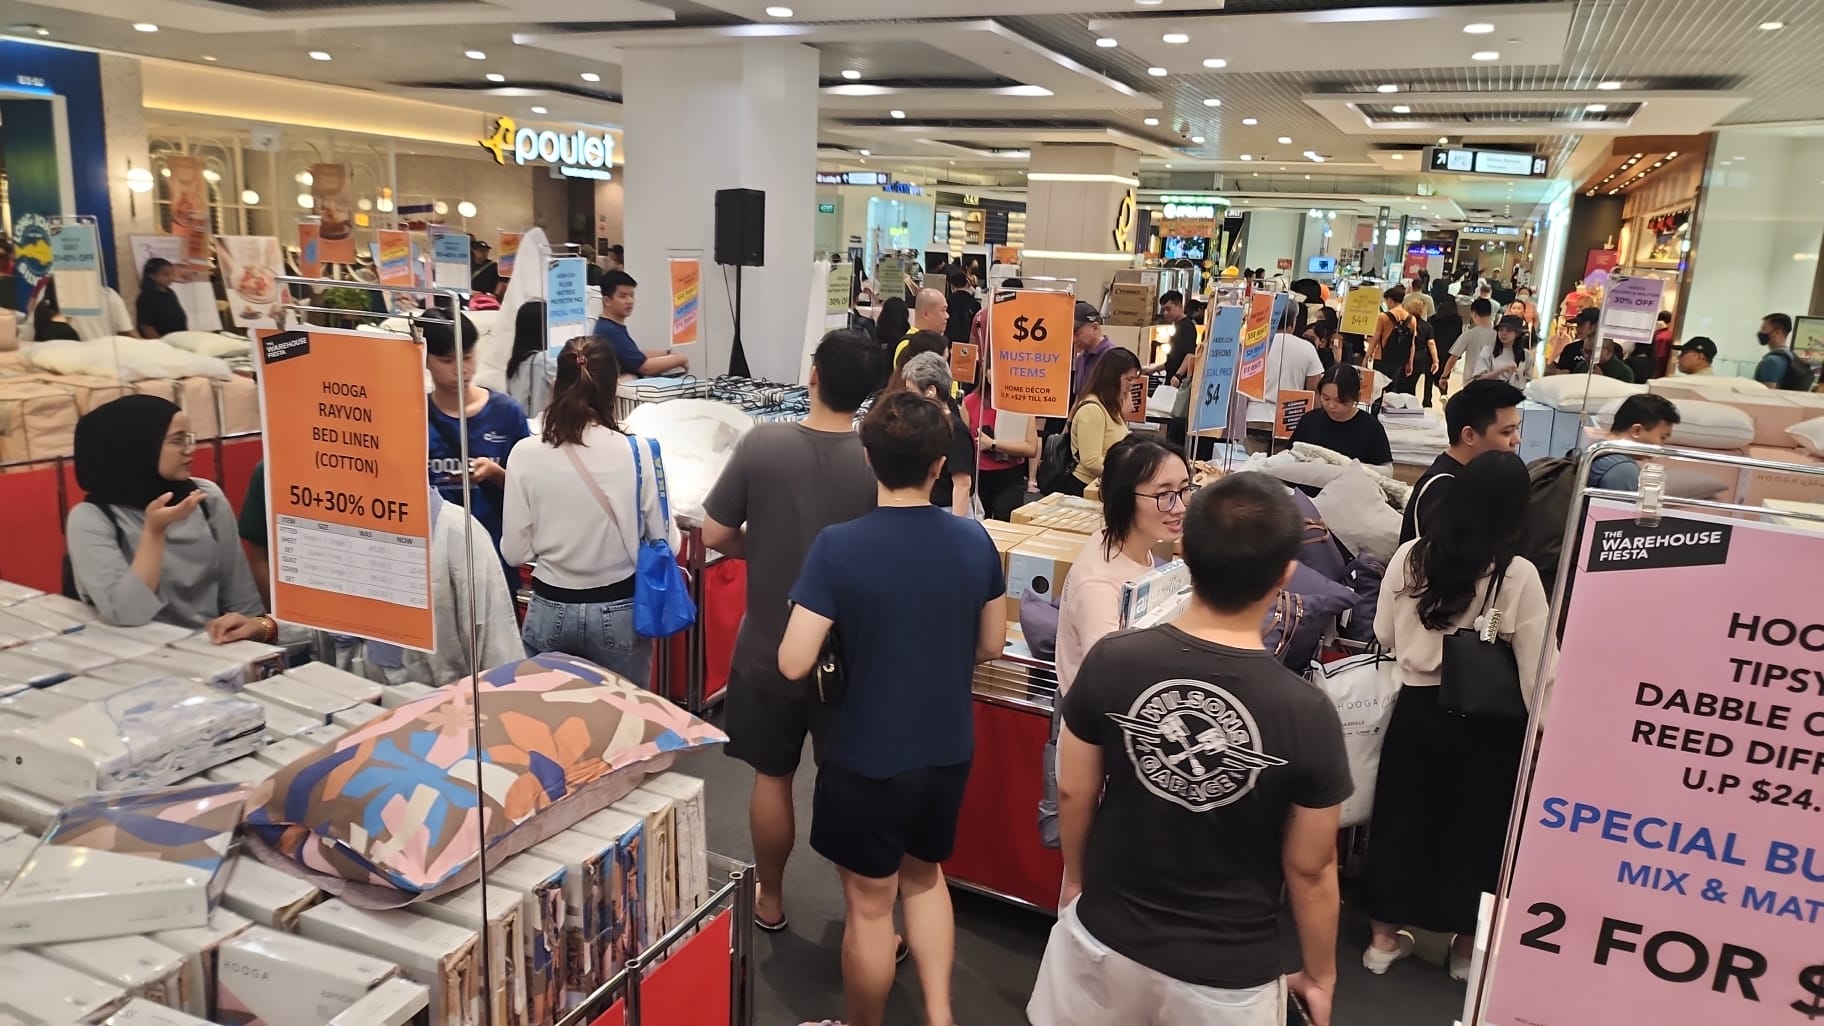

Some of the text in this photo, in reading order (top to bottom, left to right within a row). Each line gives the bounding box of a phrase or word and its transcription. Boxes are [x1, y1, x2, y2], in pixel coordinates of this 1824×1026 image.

[515, 127, 615, 169] poulet
[1613, 296, 1633, 305] 30%
[1012, 314, 1048, 342] $6
[266, 337, 308, 352] WAREHOUSE
[267, 350, 287, 358] FIESTA
[1000, 350, 1060, 363] MUST-BUY
[1009, 367, 1046, 378] ITEMS
[322, 380, 368, 399] HOOGA
[1004, 384, 1050, 394] HOME DÉCOR
[1204, 383, 1221, 407] $4
[318, 402, 373, 423] RAYVON
[312, 426, 380, 449] BED LINEN
[315, 451, 379, 477] (COTTON)
[289, 484, 409, 522] 50+30% OFF
[281, 517, 296, 525] ITEM
[359, 530, 373, 538] WAS
[396, 537, 413, 545] NOW
[1601, 531, 1723, 551] WAREHOUSE
[1603, 530, 1624, 538] THE
[1599, 548, 1649, 562] FIESTA
[1337, 698, 1378, 710] HOOGA
[1634, 681, 1792, 731] DABBLE
[1140, 690, 1251, 746] WILSONS
[1631, 719, 1735, 758] REED
[1138, 754, 1238, 802] GARAGE
[1682, 766, 1822, 813] U.P $24.
[1539, 796, 1747, 867] SPECIAL
[1616, 860, 1824, 925] MIX & MAT
[1519, 901, 1567, 955] 2
[1593, 916, 1768, 1003] FOR
[223, 960, 269, 982] HOOGA
